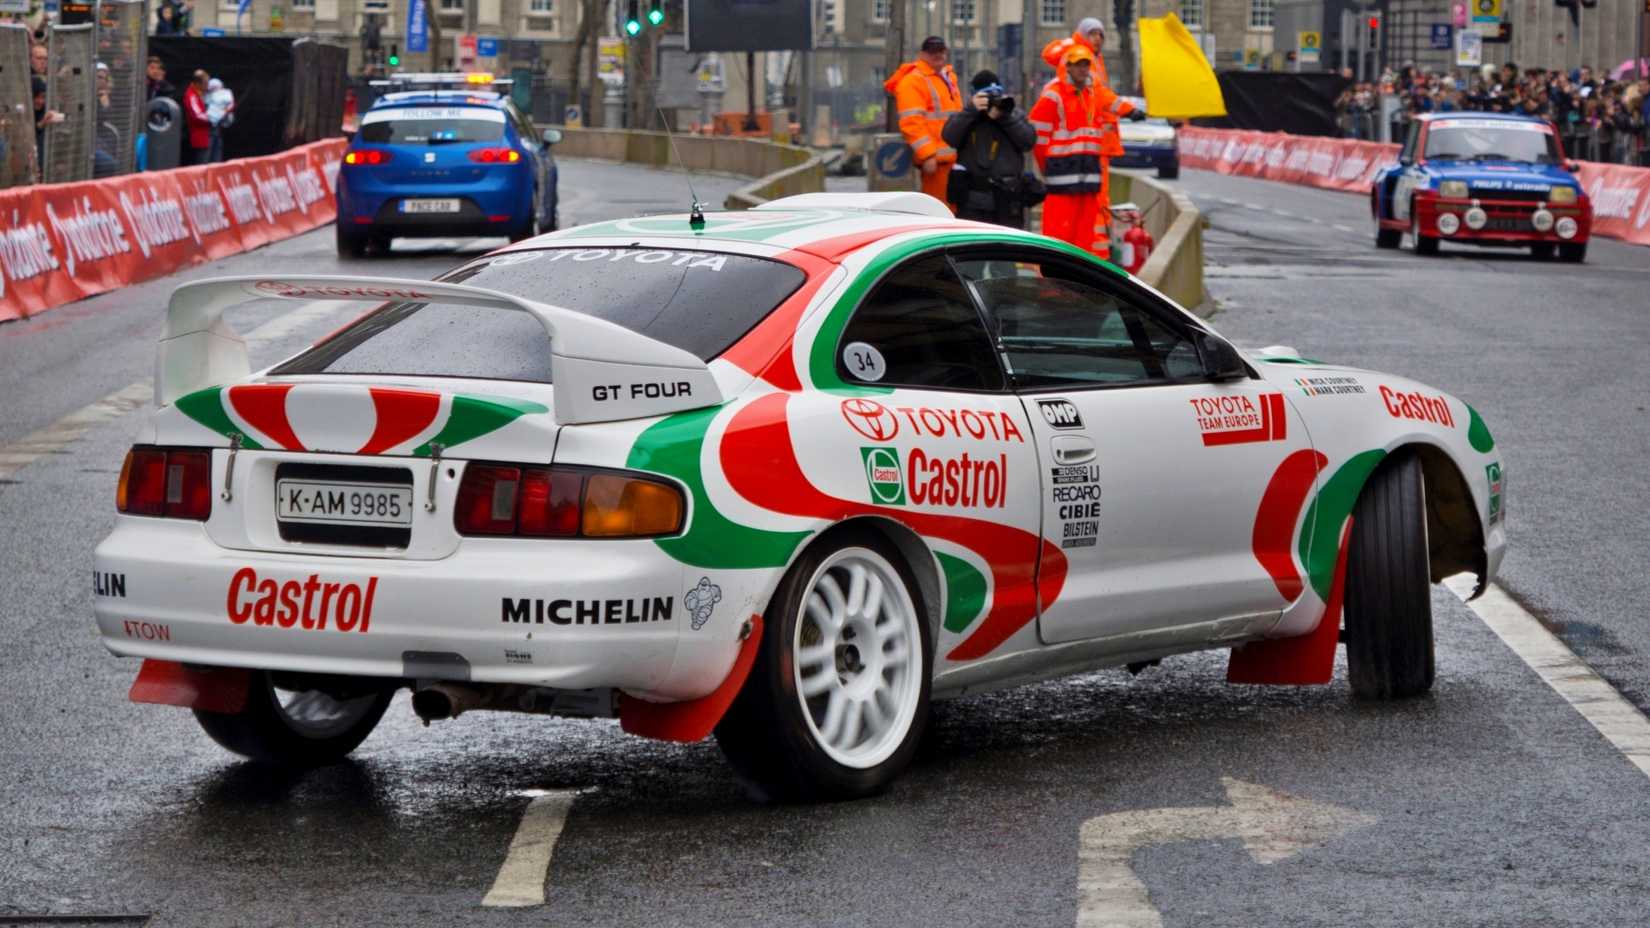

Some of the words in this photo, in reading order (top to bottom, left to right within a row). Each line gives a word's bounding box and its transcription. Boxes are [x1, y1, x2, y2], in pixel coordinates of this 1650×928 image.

[551, 249, 728, 272] TOYOTA
[854, 352, 876, 371] 34
[592, 385, 621, 401] GT
[631, 382, 692, 398] FOUR
[1041, 403, 1077, 424] OMP
[1190, 396, 1255, 416] TOYOTA
[1379, 385, 1455, 428] Castrol
[897, 407, 1024, 443] TOYOTA
[1198, 417, 1223, 430] TEAM
[1224, 414, 1260, 428] EUROPE
[874, 468, 898, 482] Castrol
[907, 448, 1007, 509] Castrol
[350, 491, 401, 517] 9985
[1053, 485, 1101, 503] RECARO
[1064, 520, 1099, 537] BILSTEIN
[226, 567, 378, 633] Castrol
[501, 596, 674, 625] MICHELIN
[129, 620, 170, 641] TOW
